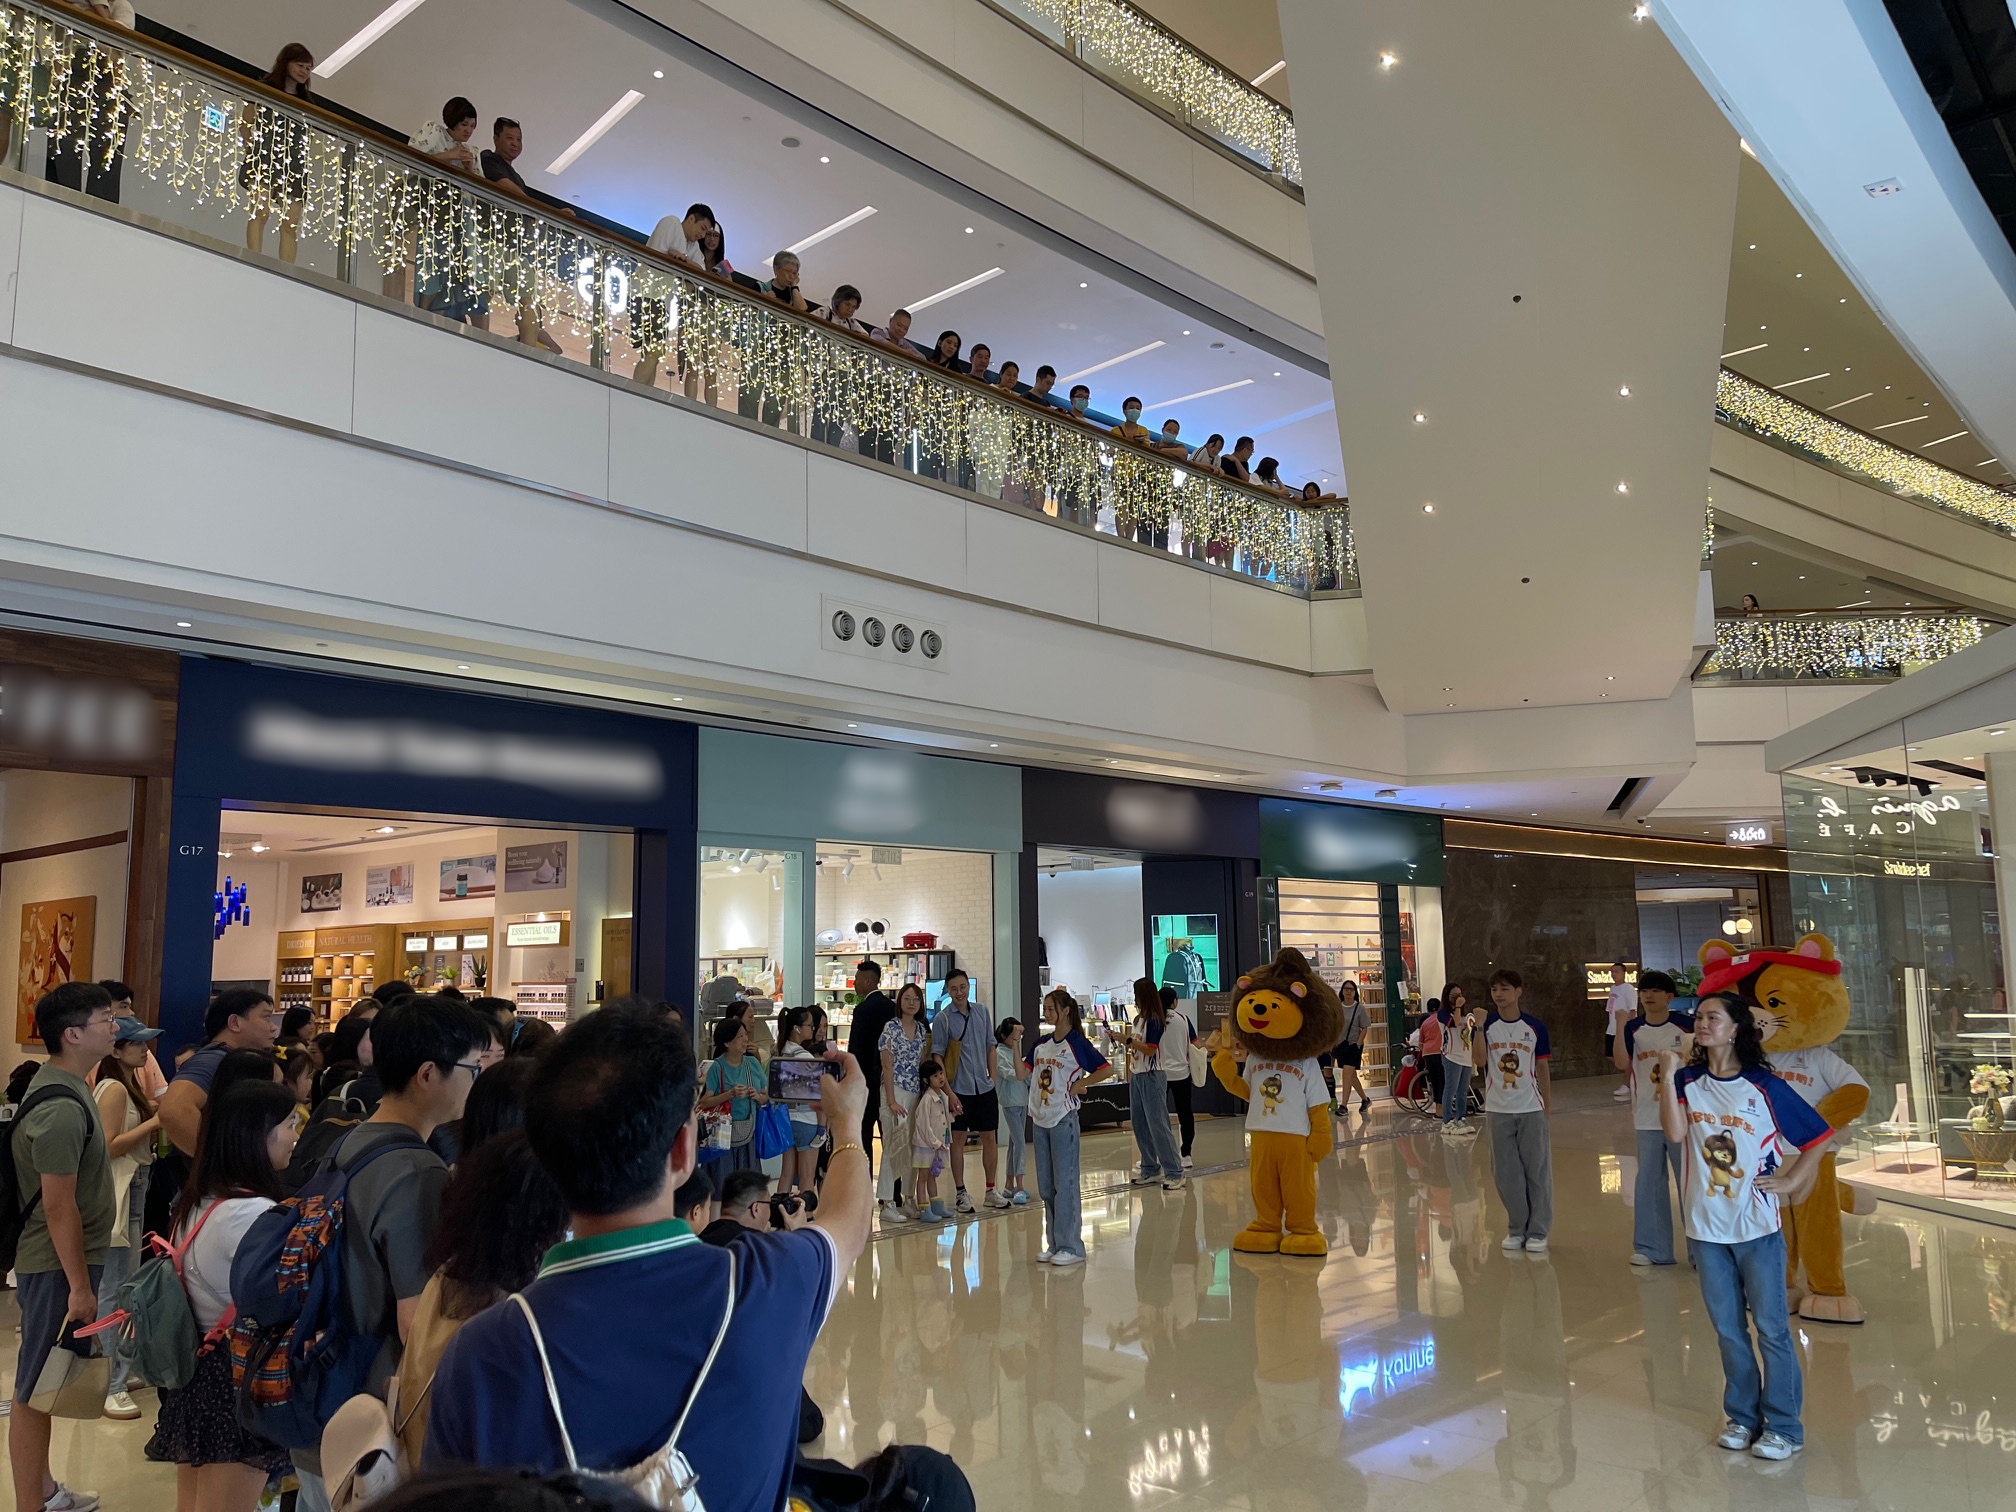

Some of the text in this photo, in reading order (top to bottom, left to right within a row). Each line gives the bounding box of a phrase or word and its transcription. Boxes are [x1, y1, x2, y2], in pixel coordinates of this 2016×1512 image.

[179, 845, 204, 856] G17
[1884, 860, 1931, 877] Sawadeehef
[511, 925, 557, 936] ESSENTIAL OILS
